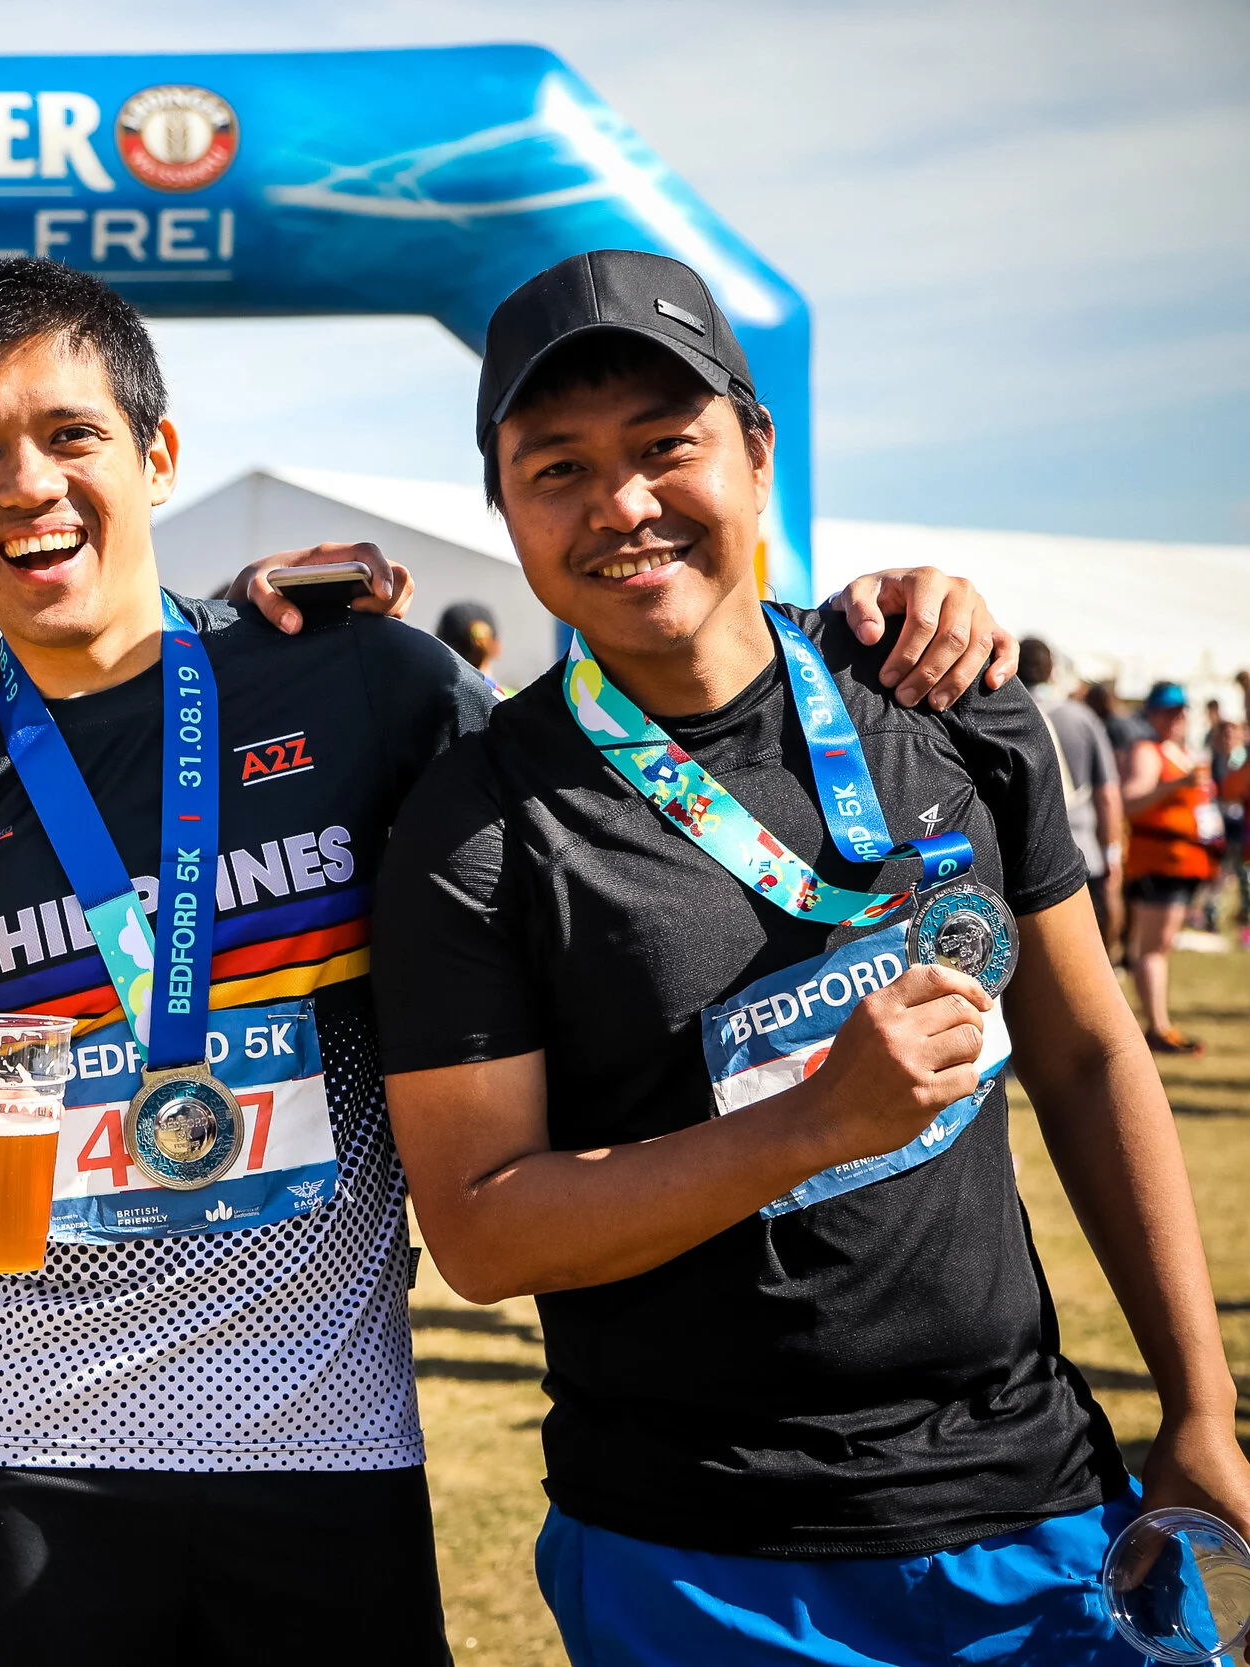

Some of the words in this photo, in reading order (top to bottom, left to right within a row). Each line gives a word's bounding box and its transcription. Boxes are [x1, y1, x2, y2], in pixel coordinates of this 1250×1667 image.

[178, 665, 204, 788] 31.08.19
[242, 736, 314, 781] A2Z
[832, 782, 863, 817] 5K
[176, 846, 202, 883] 5K
[167, 892, 199, 1014] BEDFORD
[729, 951, 903, 1046] BEDFORD
[244, 1022, 295, 1060] 5K
[77, 1092, 275, 1188] 47
[116, 1206, 159, 1218] BRITISH
